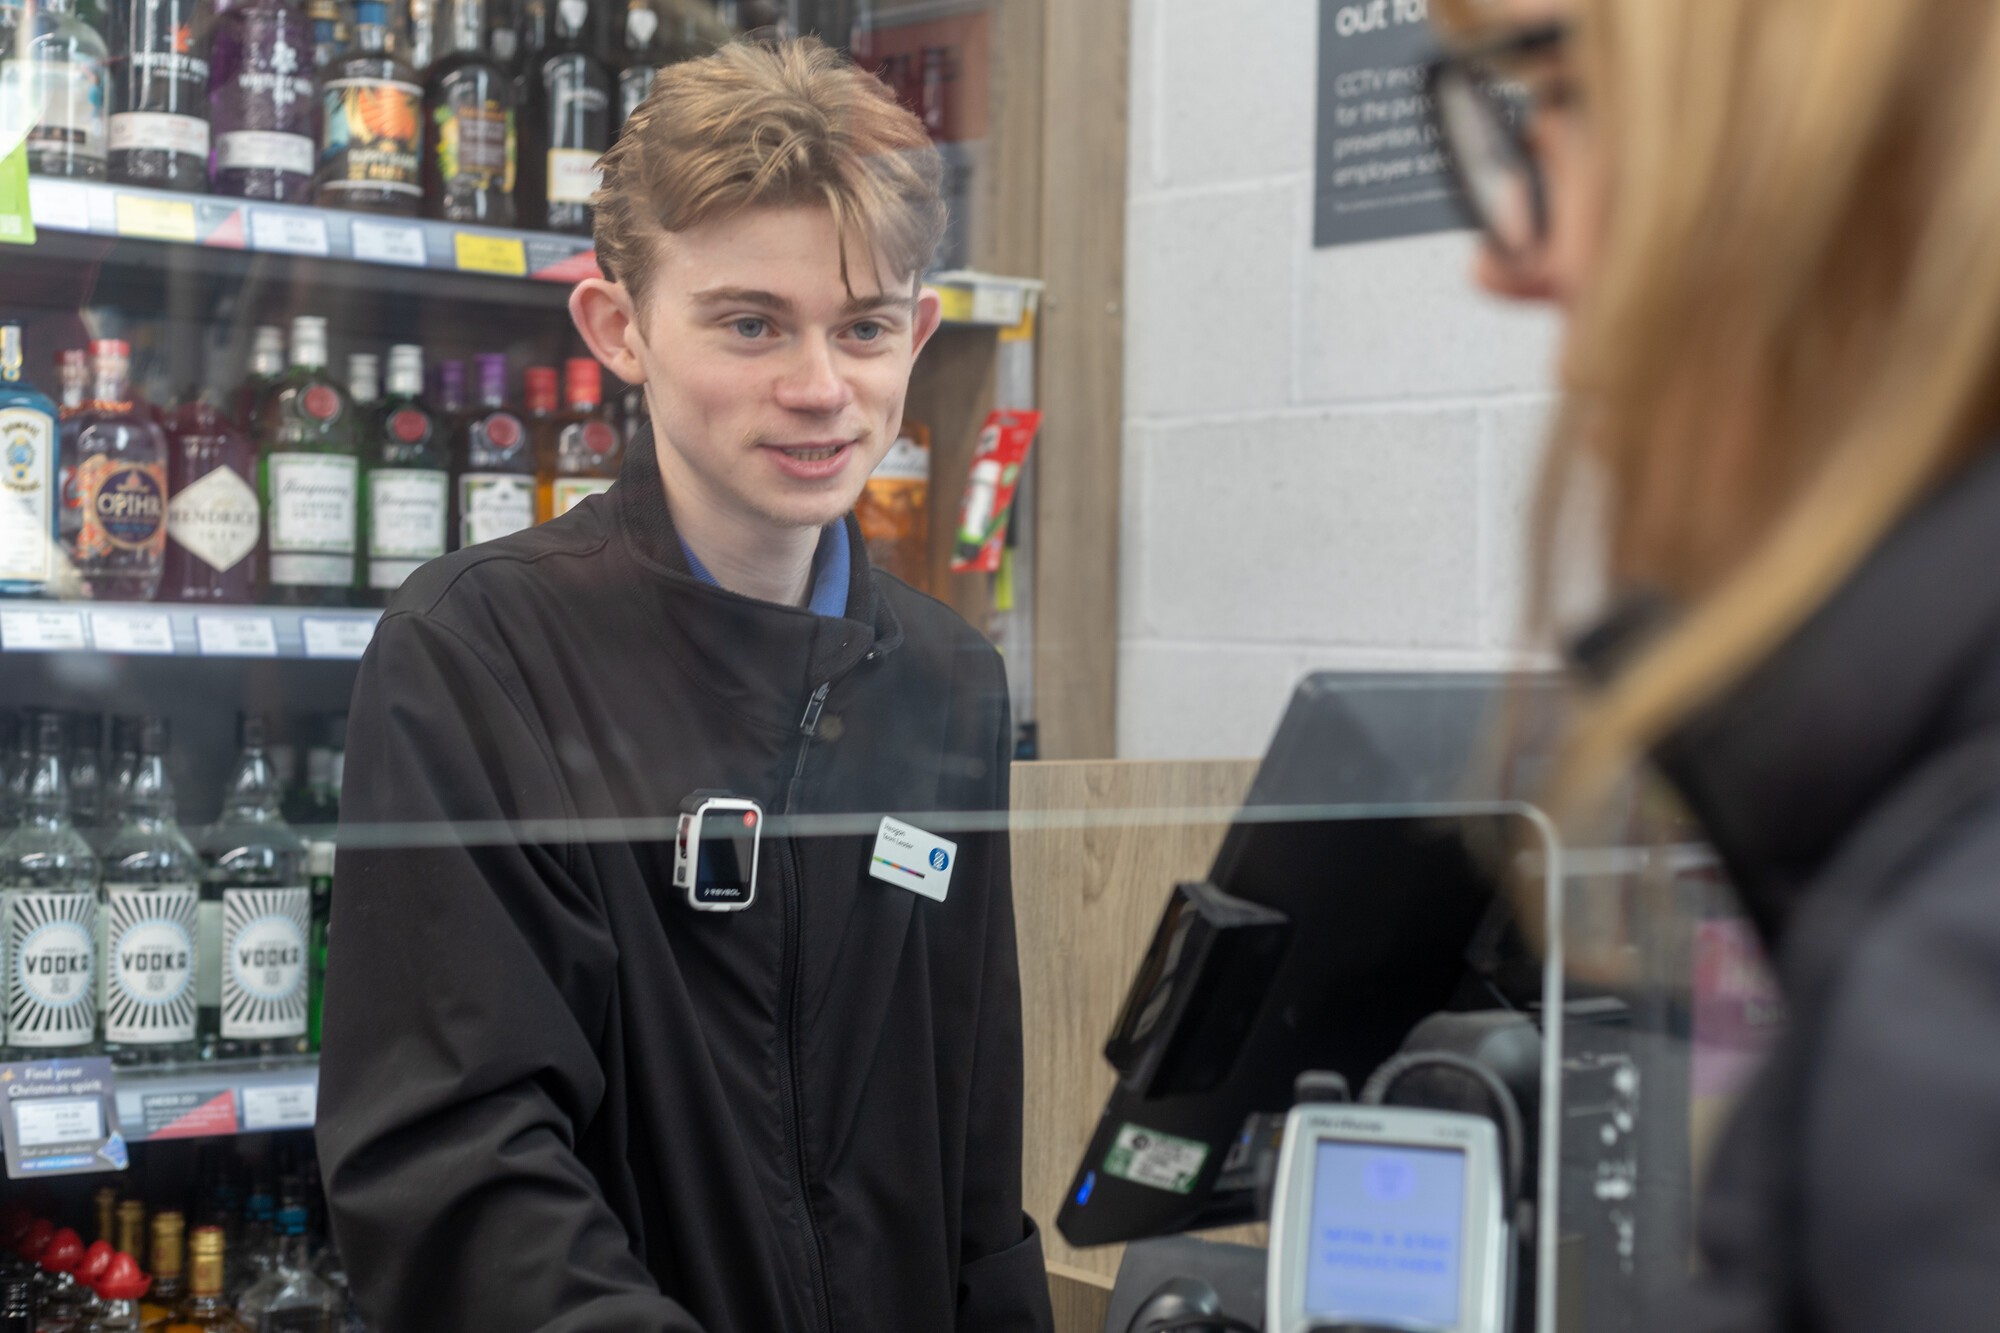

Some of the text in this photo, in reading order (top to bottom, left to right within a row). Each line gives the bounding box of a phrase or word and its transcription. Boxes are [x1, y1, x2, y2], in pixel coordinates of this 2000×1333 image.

[1335, 0, 1388, 37] out
[25, 954, 88, 975] VODKA
[122, 951, 187, 972] VODKA
[24, 1066, 83, 1083] Find your
[8, 1083, 70, 1098] Christmas
